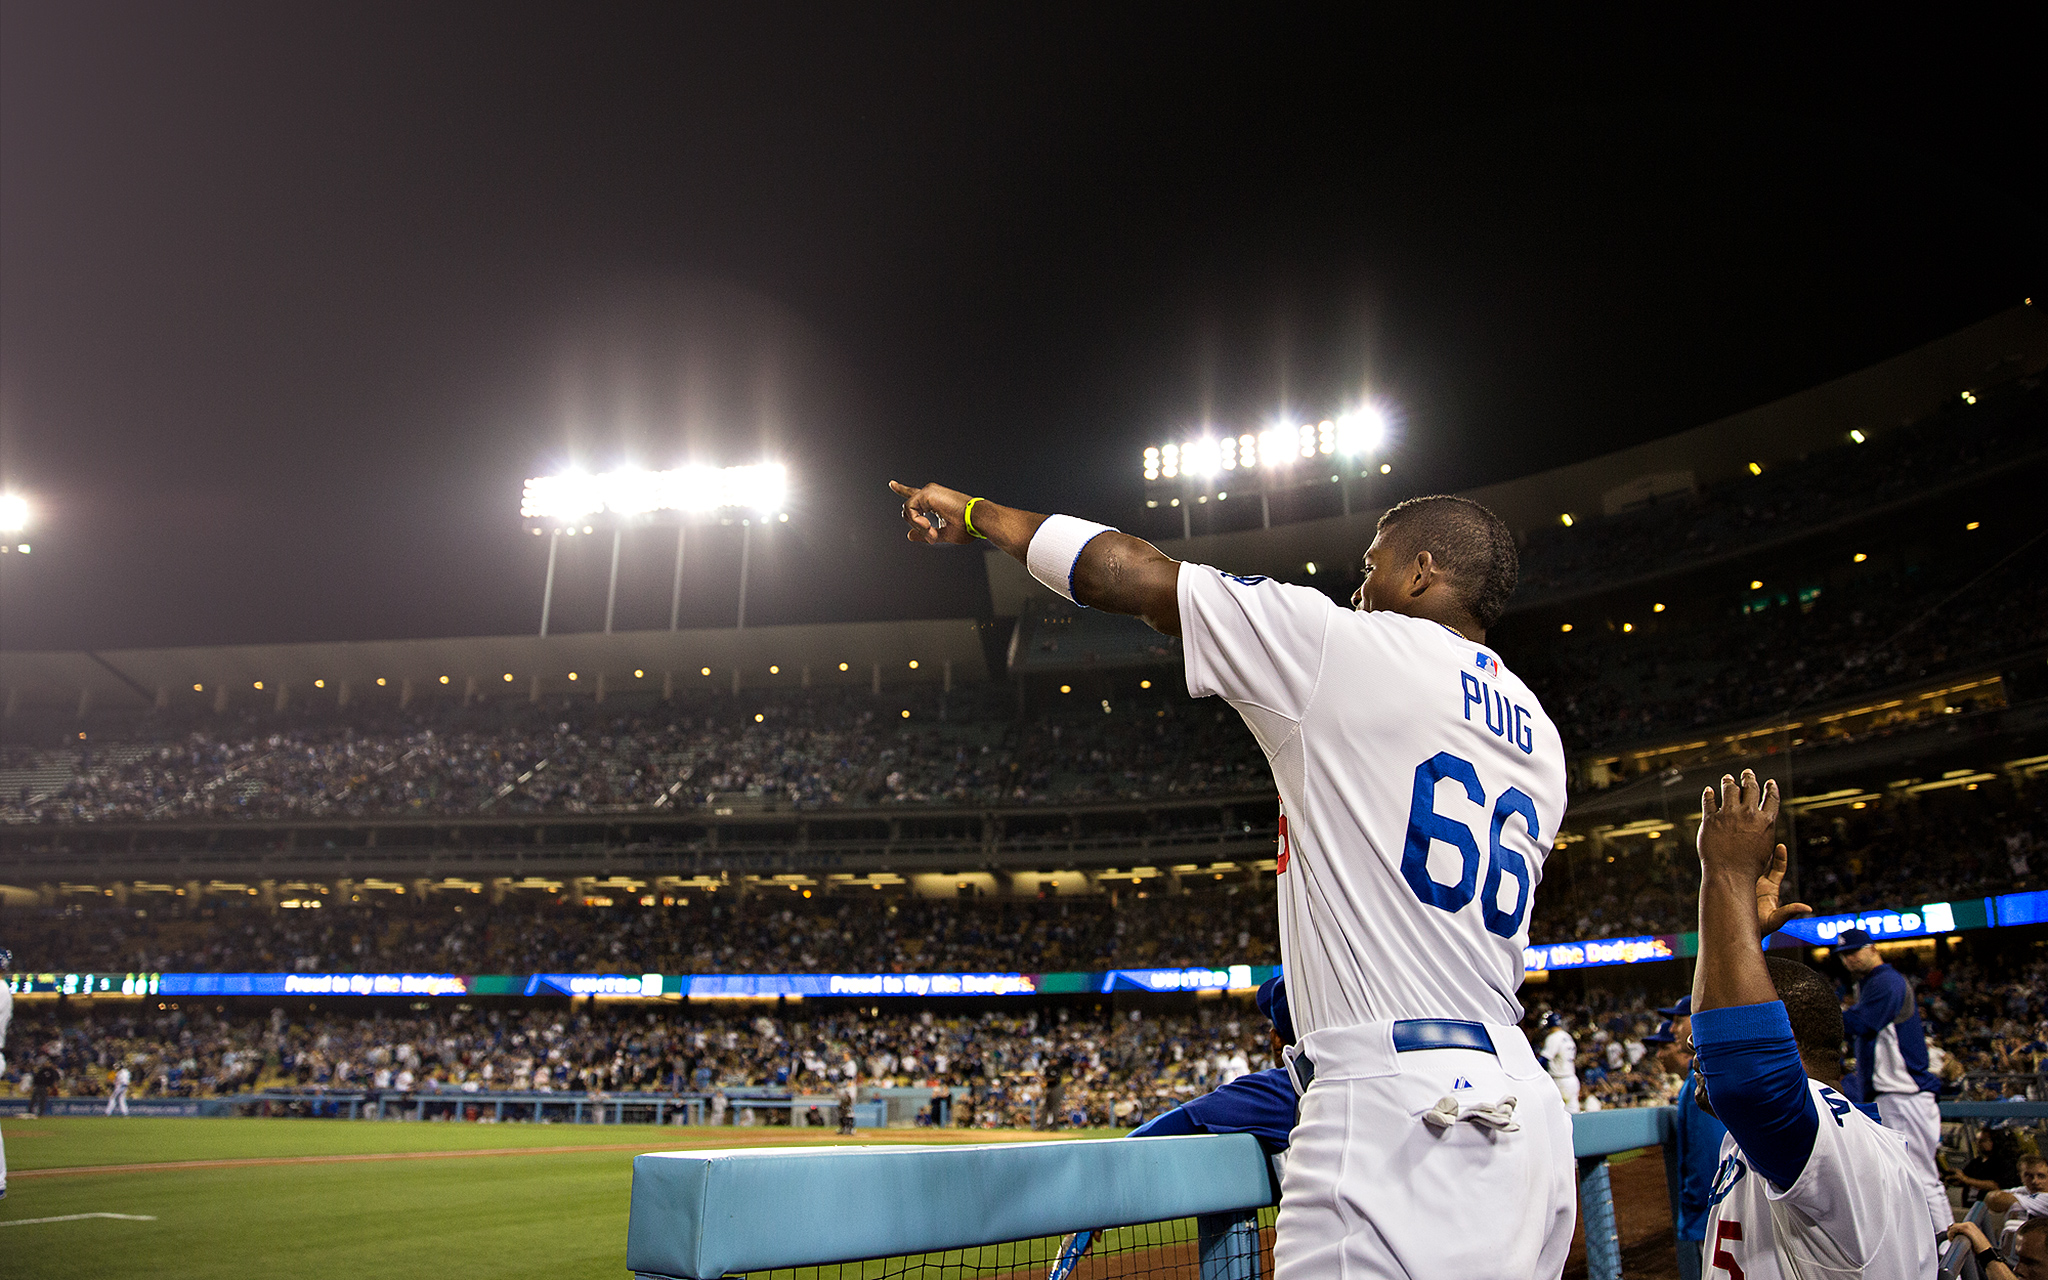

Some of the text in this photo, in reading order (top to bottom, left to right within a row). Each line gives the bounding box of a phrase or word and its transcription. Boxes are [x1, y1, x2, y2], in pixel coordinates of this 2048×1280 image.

[1461, 670, 1533, 754] PUIG
[1400, 751, 1540, 939] 66
[1817, 913, 1922, 940] UNITED
[1551, 945, 1584, 966] the
[570, 977, 642, 993] UNITED
[830, 975, 883, 993] Proud
[883, 975, 904, 993] to
[1150, 971, 1229, 988] UNITED
